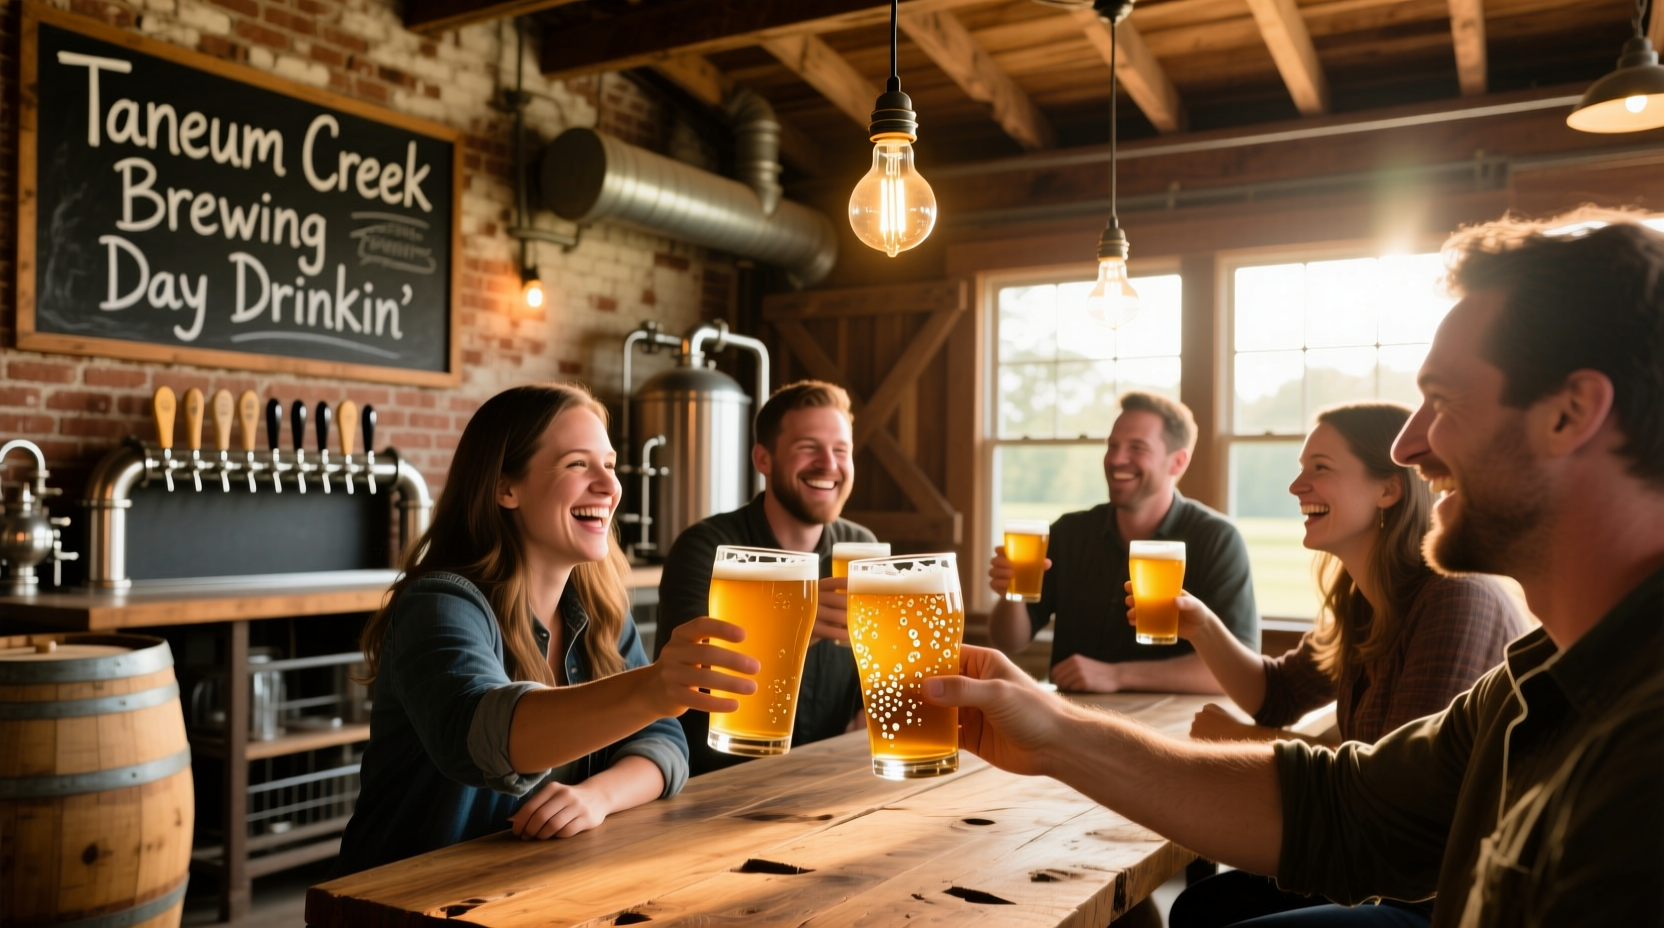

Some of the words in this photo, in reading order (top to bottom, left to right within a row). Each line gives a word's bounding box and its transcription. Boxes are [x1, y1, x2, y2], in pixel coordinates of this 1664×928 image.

[57, 51, 286, 176] Taneum
[303, 114, 432, 213] Creek
[114, 157, 326, 276] Brewing
[99, 235, 207, 341] Day
